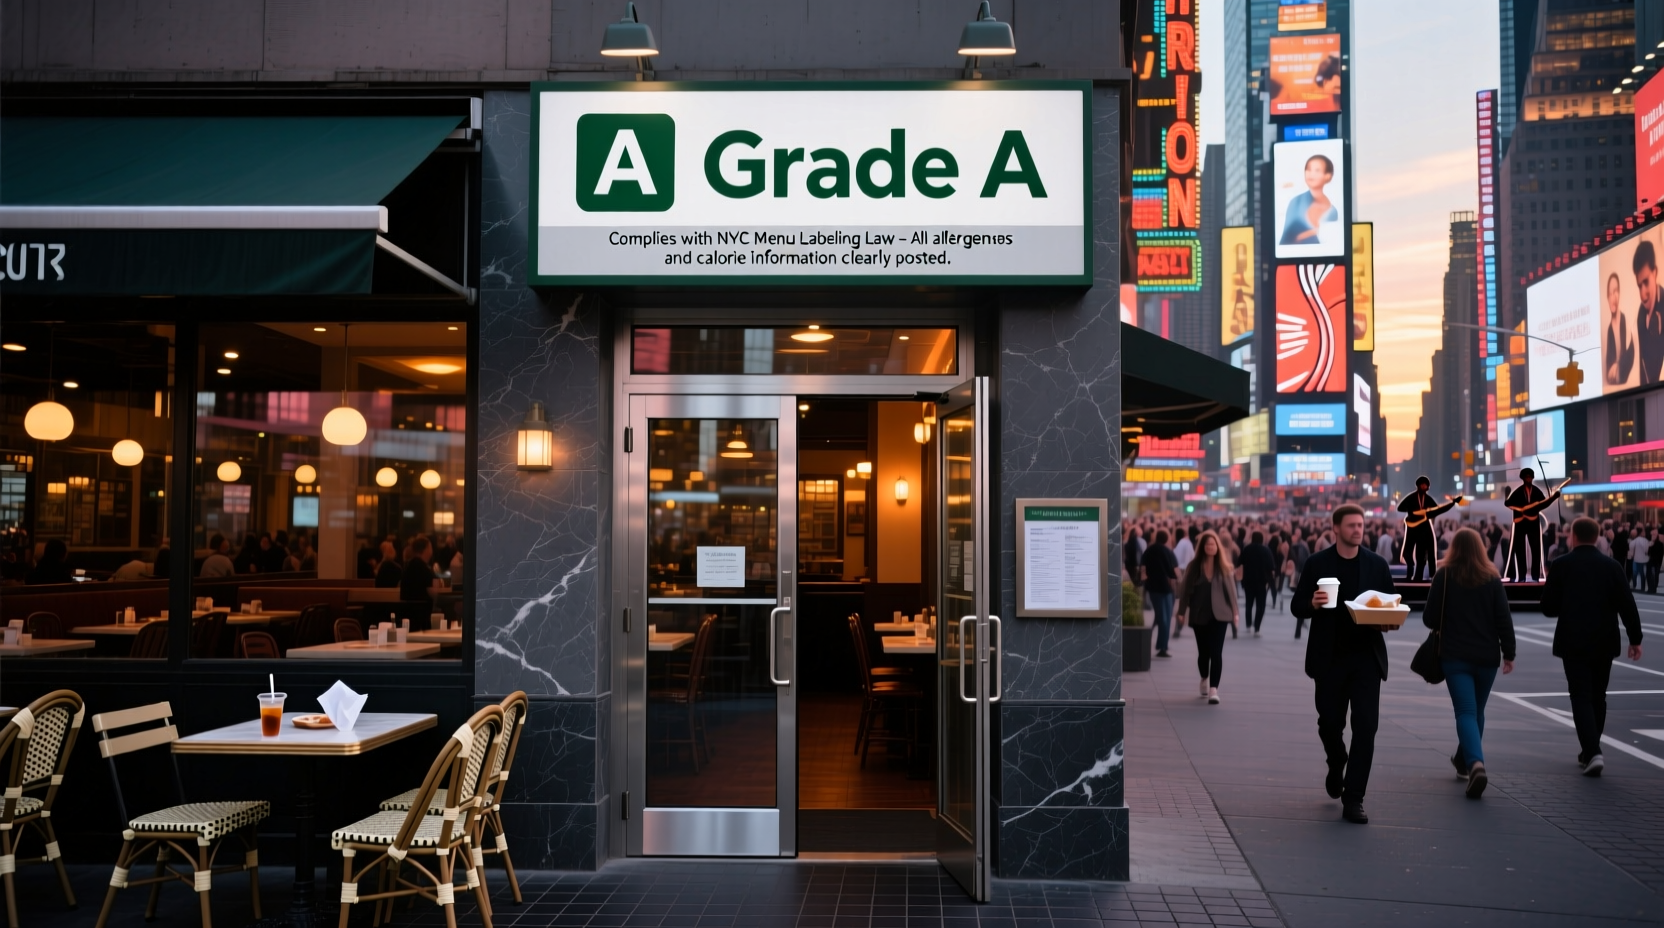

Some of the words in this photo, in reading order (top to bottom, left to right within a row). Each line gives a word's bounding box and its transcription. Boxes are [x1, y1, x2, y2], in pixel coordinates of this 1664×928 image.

[1166, 0, 1196, 228] RION
[593, 129, 658, 195] A
[704, 128, 959, 199] Grade
[979, 130, 1048, 198] A
[608, 231, 677, 249] Complies
[680, 230, 713, 246] with
[717, 231, 750, 245] NYC
[754, 231, 796, 245] Menu
[800, 230, 861, 250] Labeling
[865, 231, 895, 245] Law
[910, 230, 928, 245] All
[664, 250, 692, 265] and
[696, 249, 747, 265] calorie
[751, 248, 837, 265] information
[841, 249, 891, 269] clearly
[896, 250, 951, 269] posted.
